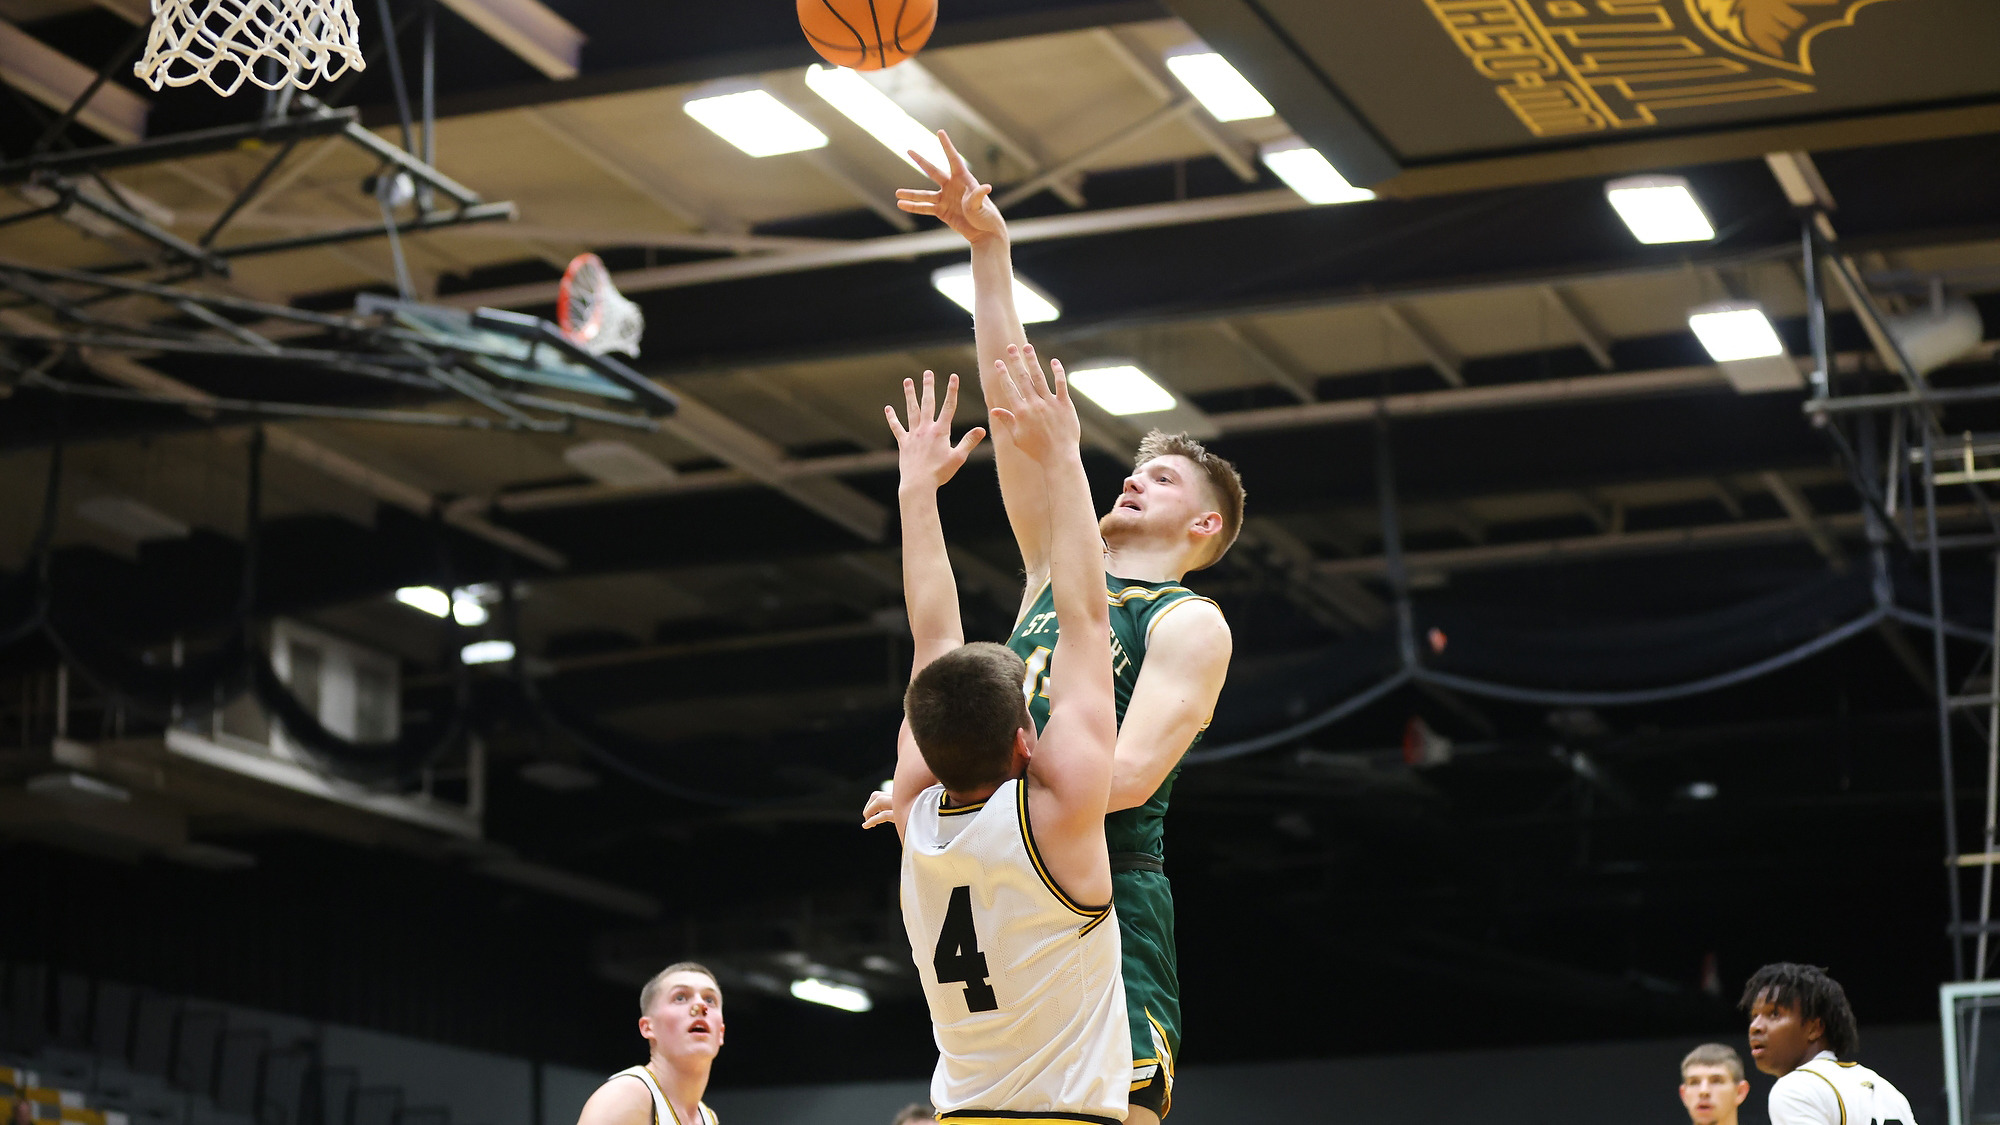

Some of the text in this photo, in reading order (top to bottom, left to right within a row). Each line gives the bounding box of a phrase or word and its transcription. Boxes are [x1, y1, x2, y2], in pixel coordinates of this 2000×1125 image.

[1021, 611, 1057, 637] ST.
[1023, 645, 1053, 716] 1
[933, 885, 999, 1014] 4
